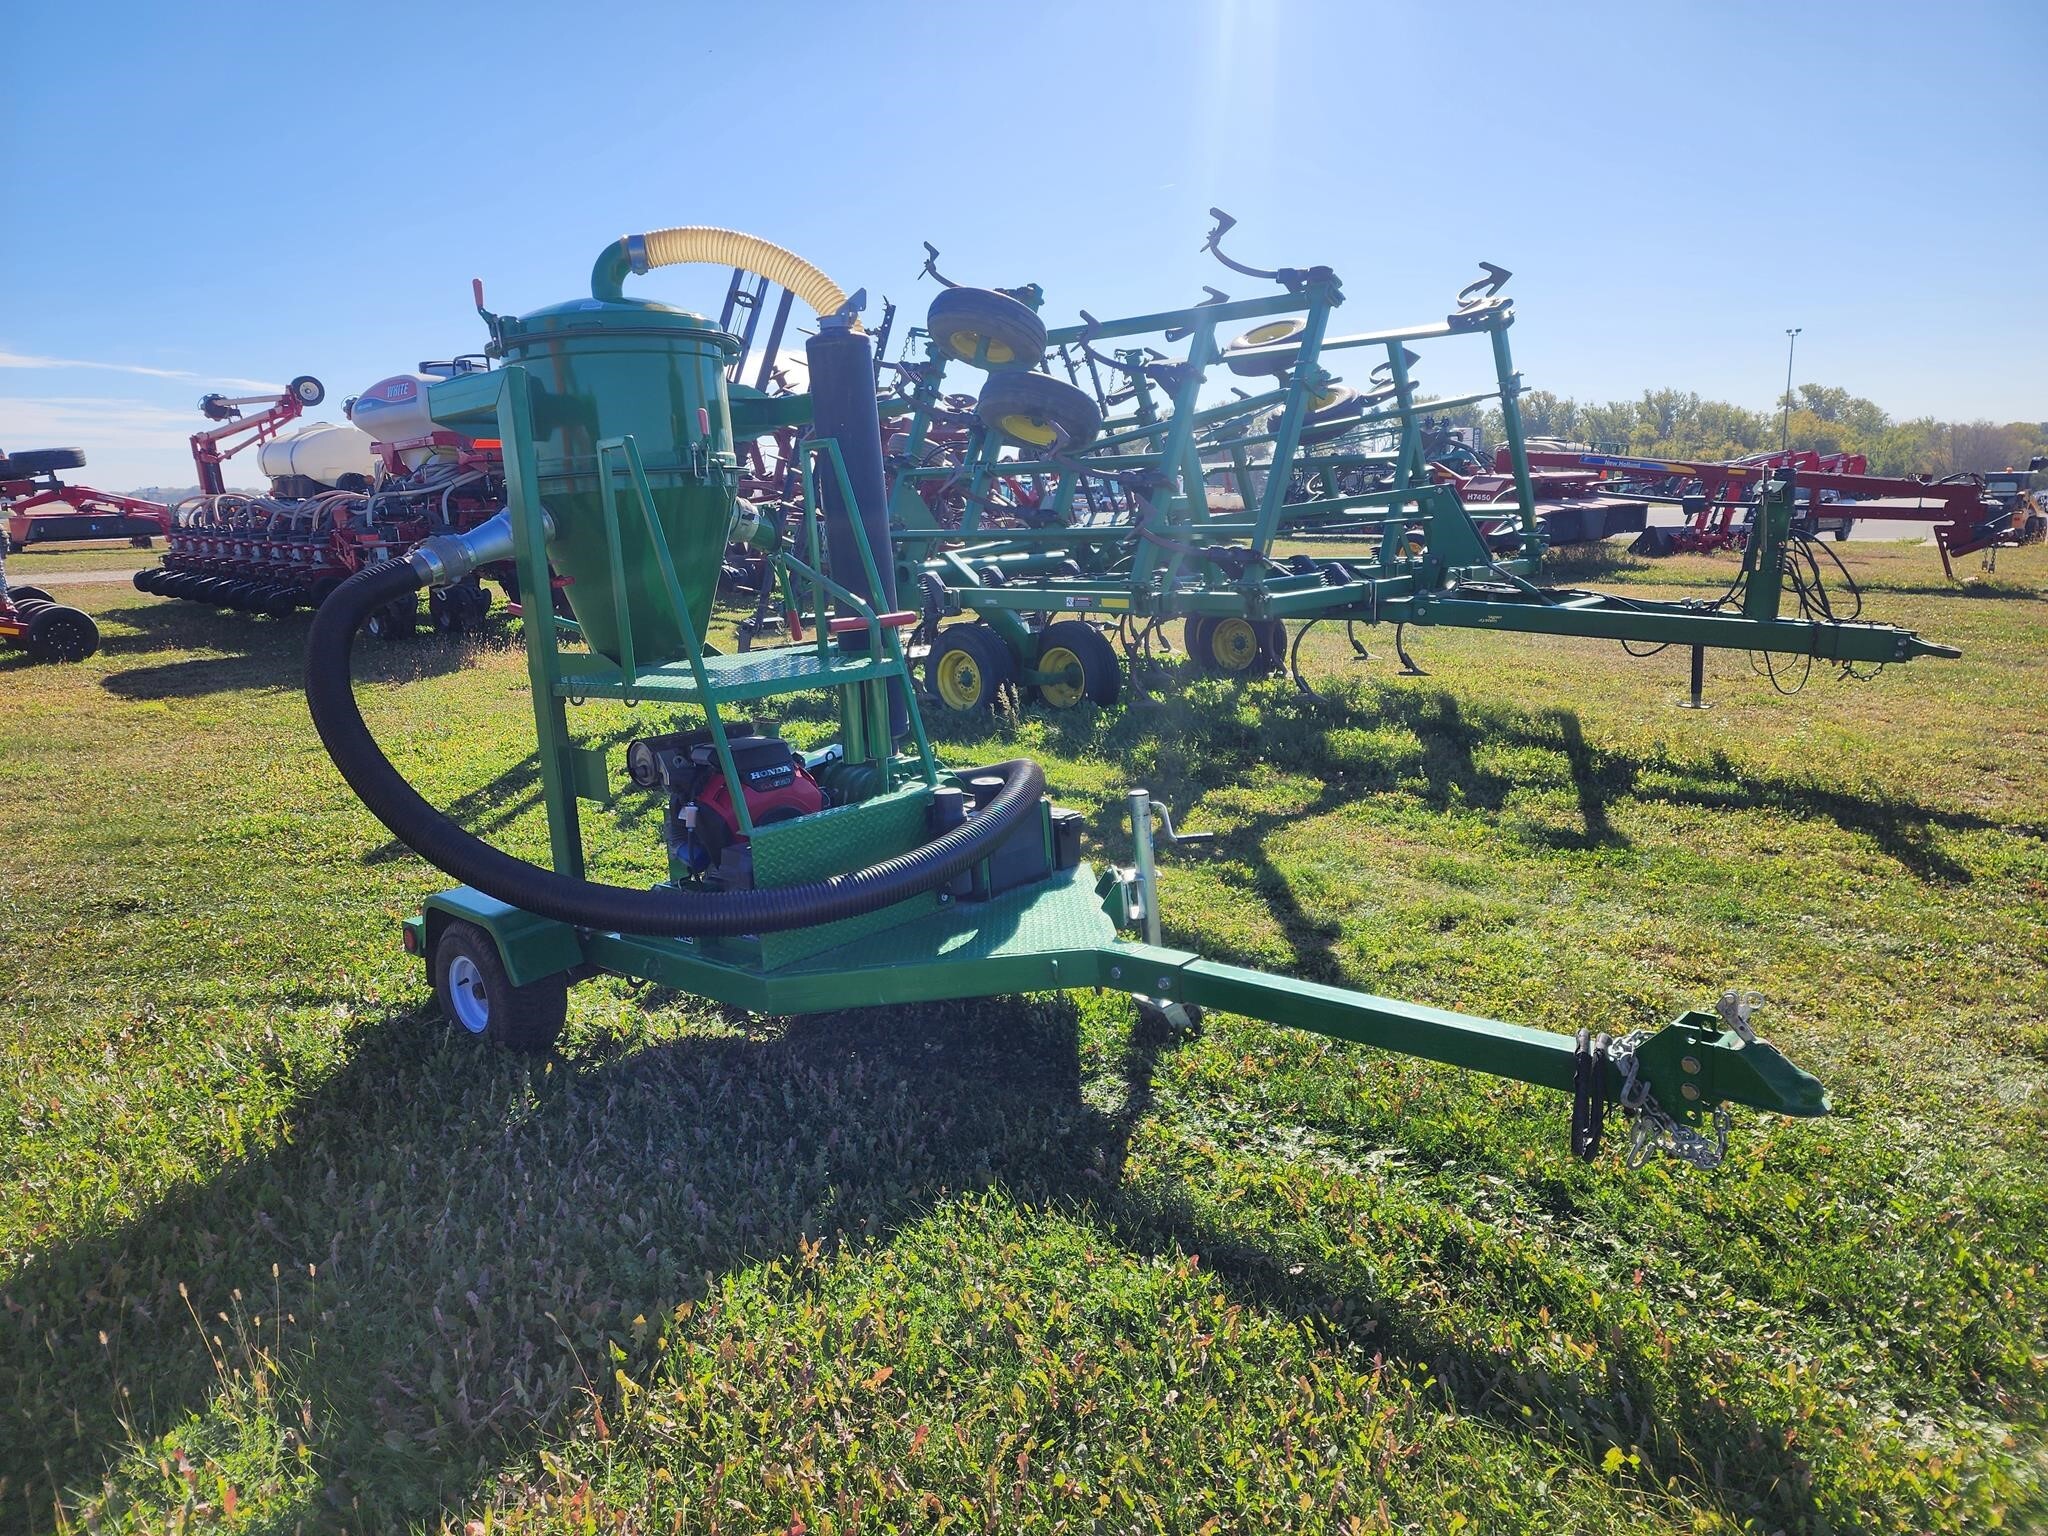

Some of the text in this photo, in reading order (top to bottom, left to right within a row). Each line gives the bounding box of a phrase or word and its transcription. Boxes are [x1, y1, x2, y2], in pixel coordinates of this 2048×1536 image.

[387, 382, 409, 398] WHITE
[1604, 459, 1641, 469] New Holland
[1467, 493, 1491, 501] H7450
[750, 765, 791, 780] HONDA
